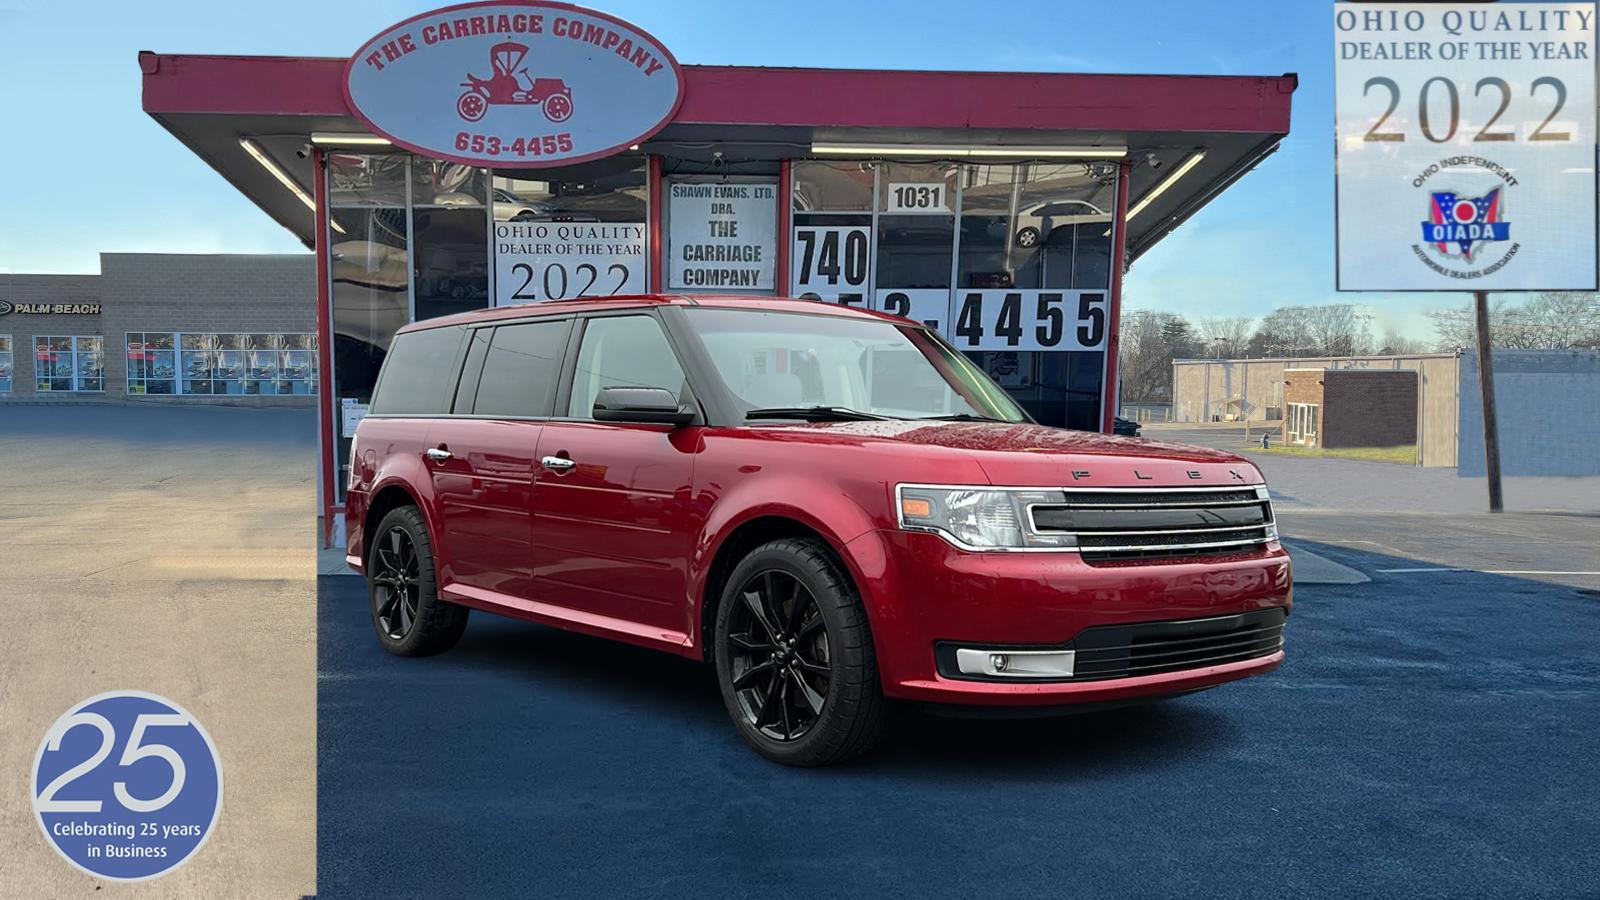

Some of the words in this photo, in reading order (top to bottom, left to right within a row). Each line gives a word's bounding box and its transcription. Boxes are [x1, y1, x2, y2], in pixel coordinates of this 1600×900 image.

[1336, 10, 1425, 32] OHIO
[1442, 10, 1592, 35] QUALITY
[366, 34, 416, 72] THE
[422, 14, 544, 45] CARRIAGE
[552, 17, 664, 77] COMPANY
[1341, 42, 1432, 60] DEALER
[1439, 42, 1469, 60] OF
[1475, 42, 1522, 60] THE
[1528, 42, 1589, 60] YEAR
[1363, 76, 1571, 143] 2022
[455, 132, 573, 156] 653-4455
[1412, 164, 1439, 188] OHIO
[1440, 155, 1519, 188] INDEPENDENT
[672, 186, 711, 199] SHAWN
[754, 187, 775, 199] LTD.
[894, 187, 940, 208] 1031
[711, 203, 736, 215] DBA.
[497, 226, 548, 239] OHIO
[558, 226, 644, 241] QUALITY
[708, 220, 738, 238] THE
[1433, 224, 1495, 240] OIADA
[499, 243, 552, 255] DEALER
[555, 243, 573, 255] OF
[576, 243, 603, 255] THE
[604, 244, 642, 255] YEAR
[683, 244, 762, 262] CARRIAGE
[797, 229, 868, 286] 740
[1411, 244, 1449, 277] AUTOMOBILE
[1449, 270, 1482, 280] DEALERS
[1483, 243, 1521, 276] ASSOCIATION
[511, 263, 630, 300] 2022
[683, 268, 761, 286] COMPANY
[15, 303, 51, 314] PALM
[54, 303, 100, 314] BEACH
[1072, 470, 1245, 482] FLEX
